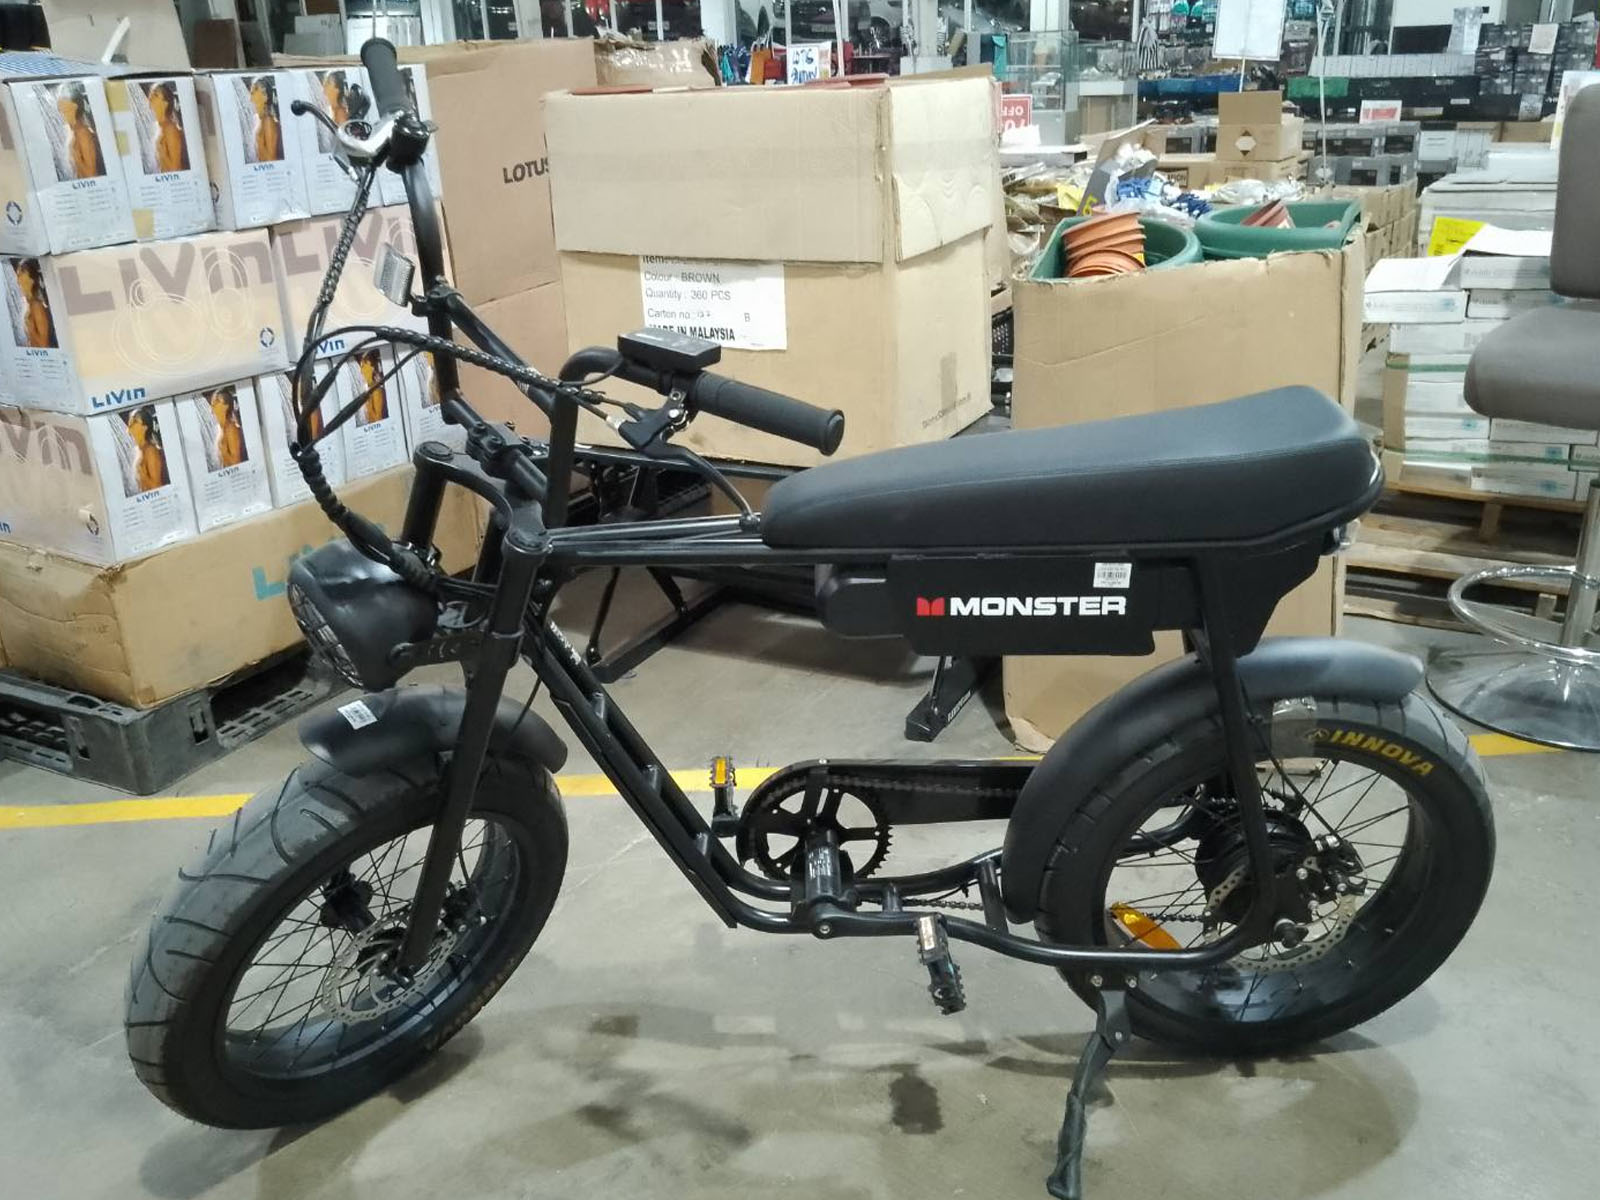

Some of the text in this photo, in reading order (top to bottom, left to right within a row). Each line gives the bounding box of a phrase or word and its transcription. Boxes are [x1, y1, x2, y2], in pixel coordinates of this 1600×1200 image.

[644, 270, 720, 283] Colour BROWN
[646, 288, 682, 301] Quantity
[691, 290, 707, 300] 360
[711, 290, 731, 301] PCS
[648, 308, 676, 318] Carton
[689, 326, 736, 341] MALAYSIA
[950, 597, 1127, 616] MONSTER
[1330, 729, 1435, 776] INNOVA
